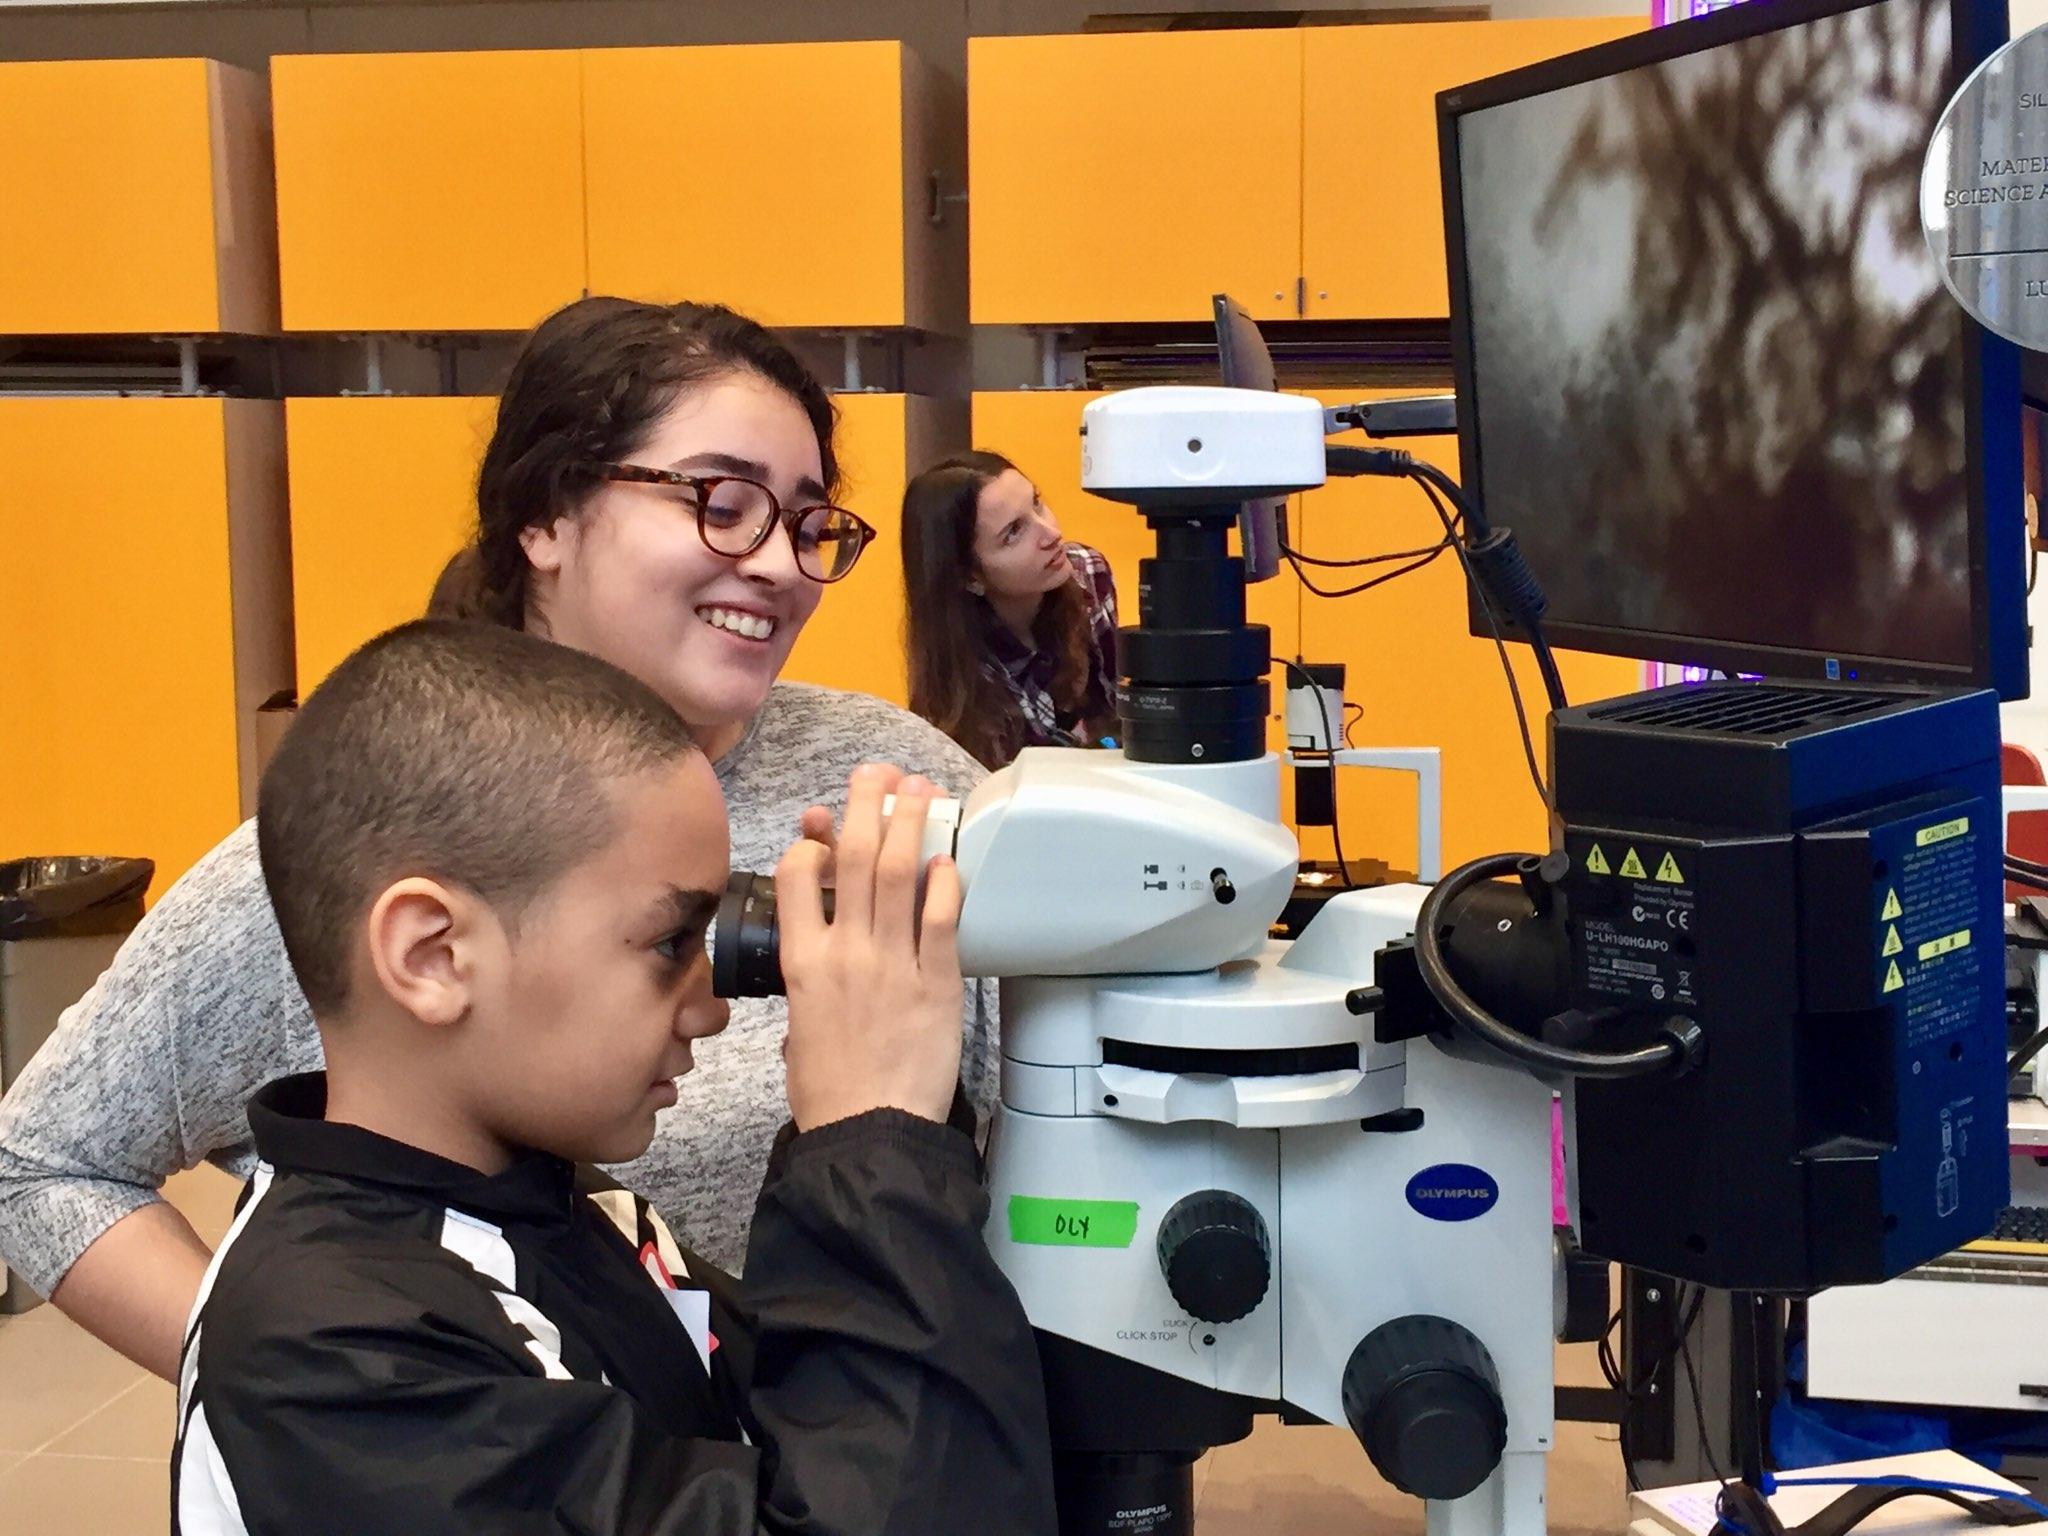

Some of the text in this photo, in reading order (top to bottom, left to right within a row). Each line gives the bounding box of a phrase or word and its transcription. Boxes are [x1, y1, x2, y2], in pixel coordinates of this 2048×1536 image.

[1945, 185, 2034, 206] SCIENCE
[1585, 930, 1669, 952] U-LH100HGAPO
[1416, 1188, 1489, 1199] OLYMPUS
[1116, 1330, 1178, 1341] CLICK STOP
[1116, 1504, 1167, 1519] OLYMPUS
